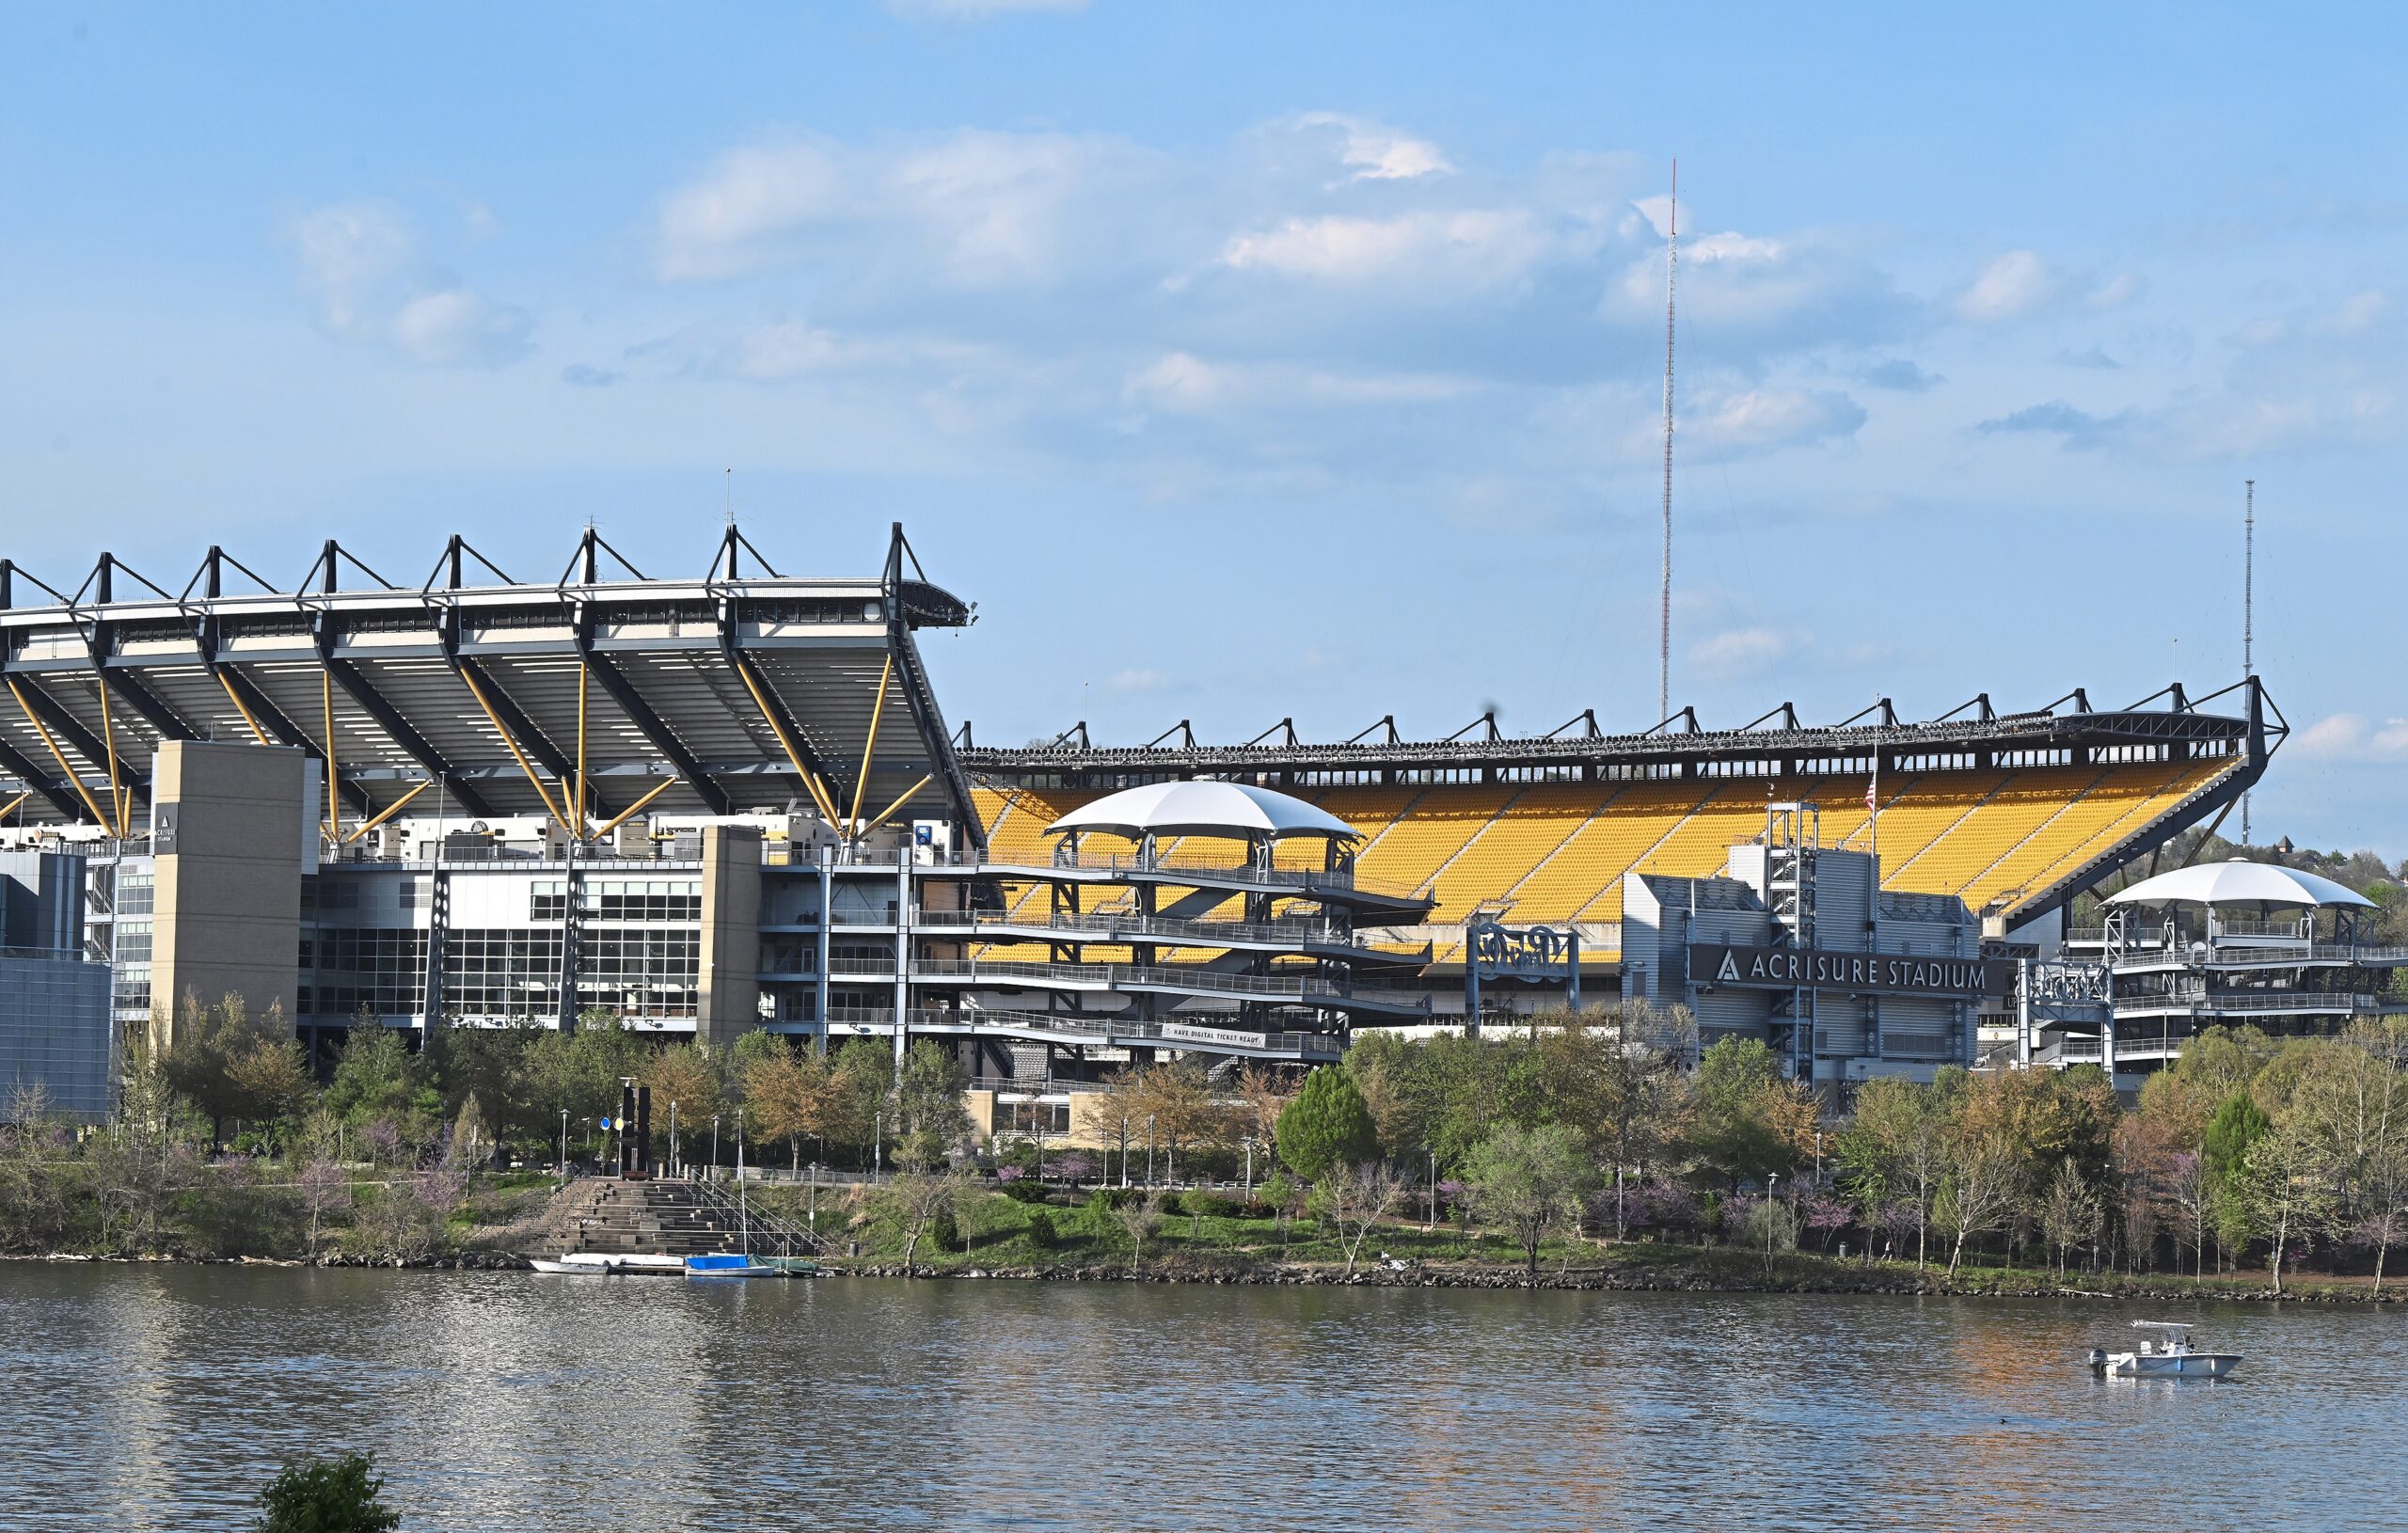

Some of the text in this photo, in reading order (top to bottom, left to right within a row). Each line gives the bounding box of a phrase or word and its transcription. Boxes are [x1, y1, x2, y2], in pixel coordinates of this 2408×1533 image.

[1750, 953, 1877, 984] ACRISURE
[1888, 959, 1986, 989] STADIUM
[1191, 1031, 1214, 1039] DIGITAL
[1216, 1033, 1237, 1041] TICKET
[1239, 1035, 1259, 1044] READY
